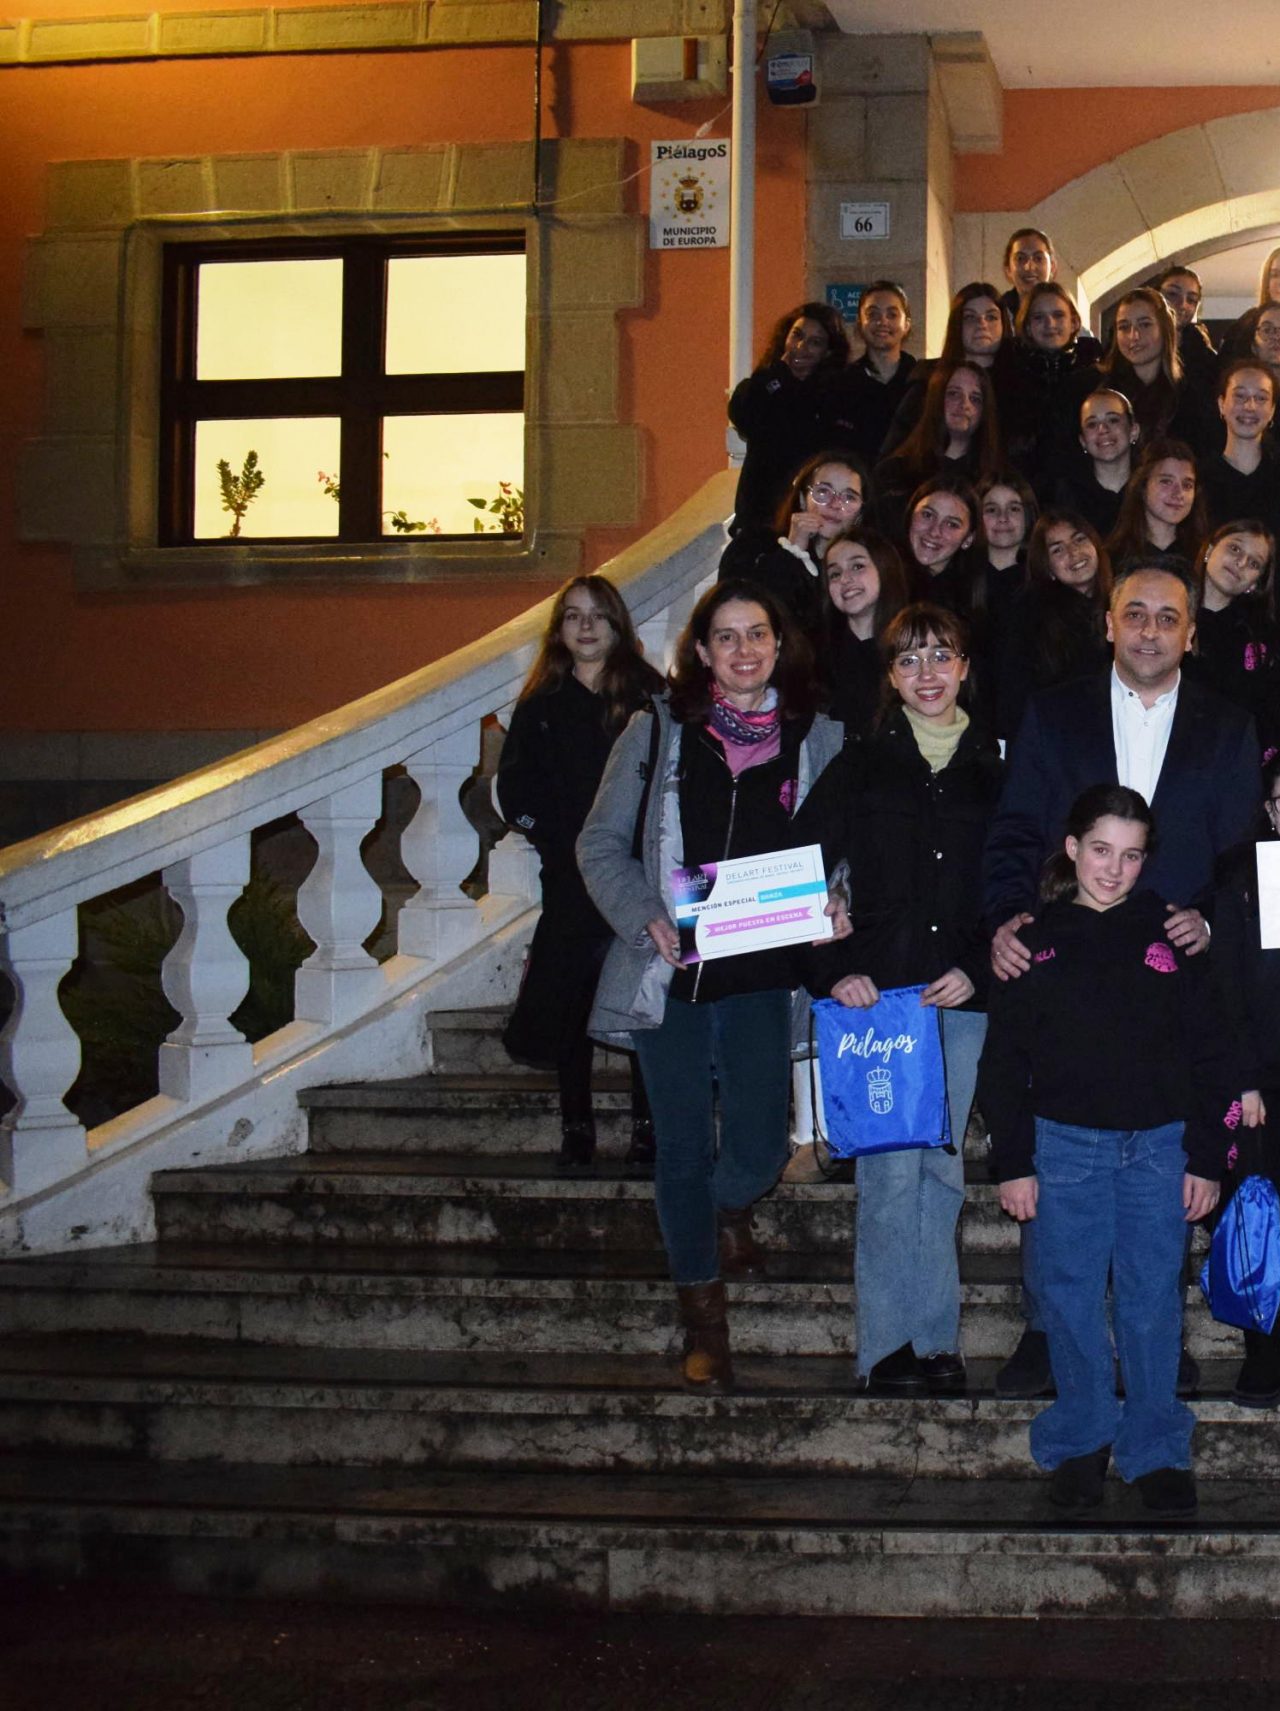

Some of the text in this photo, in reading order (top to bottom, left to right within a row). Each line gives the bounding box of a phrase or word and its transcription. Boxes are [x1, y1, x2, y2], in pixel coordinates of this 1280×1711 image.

[663, 226, 717, 236] MUNICIPIO
[854, 216, 873, 233] 66
[663, 236, 717, 246] DE EUROPA
[726, 868, 759, 881] DELART
[762, 861, 804, 874] FESTIVAL
[691, 902, 722, 912] MENCIÓN
[724, 896, 756, 907] ESPECIAL
[714, 911, 803, 933] MEJOR PUESTA EN ESCENA
[837, 1026, 918, 1063] Piélagos
